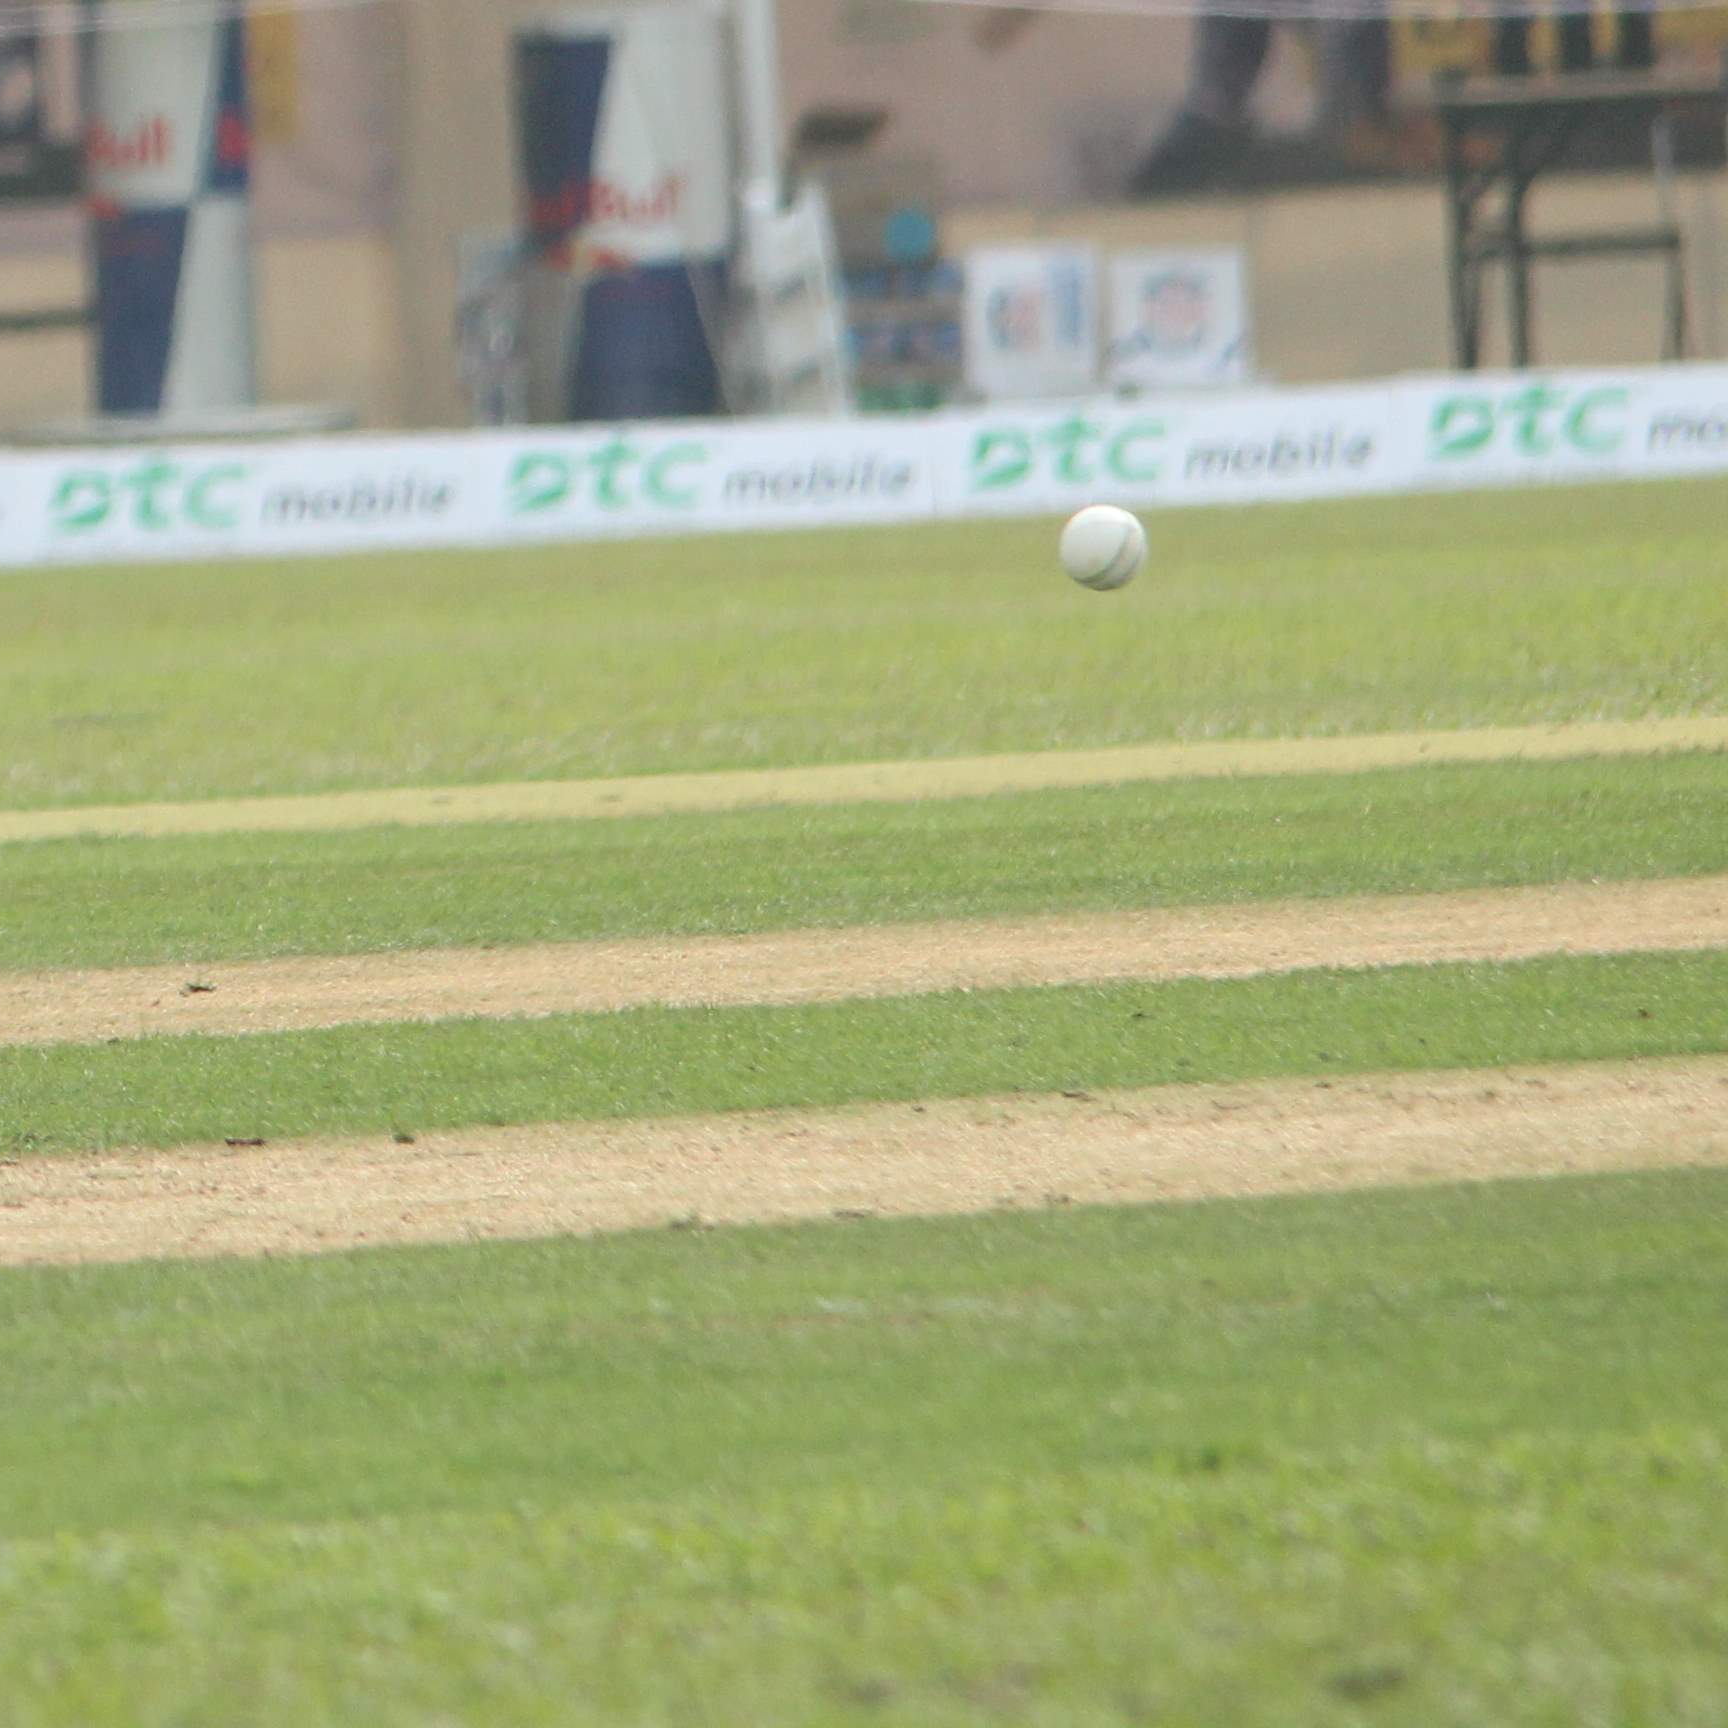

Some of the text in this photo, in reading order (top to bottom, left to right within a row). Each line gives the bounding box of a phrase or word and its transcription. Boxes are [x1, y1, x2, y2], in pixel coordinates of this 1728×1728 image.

[1185, 425, 1378, 477] mobile
[261, 474, 454, 525] mobile
[724, 454, 911, 505] mobile
